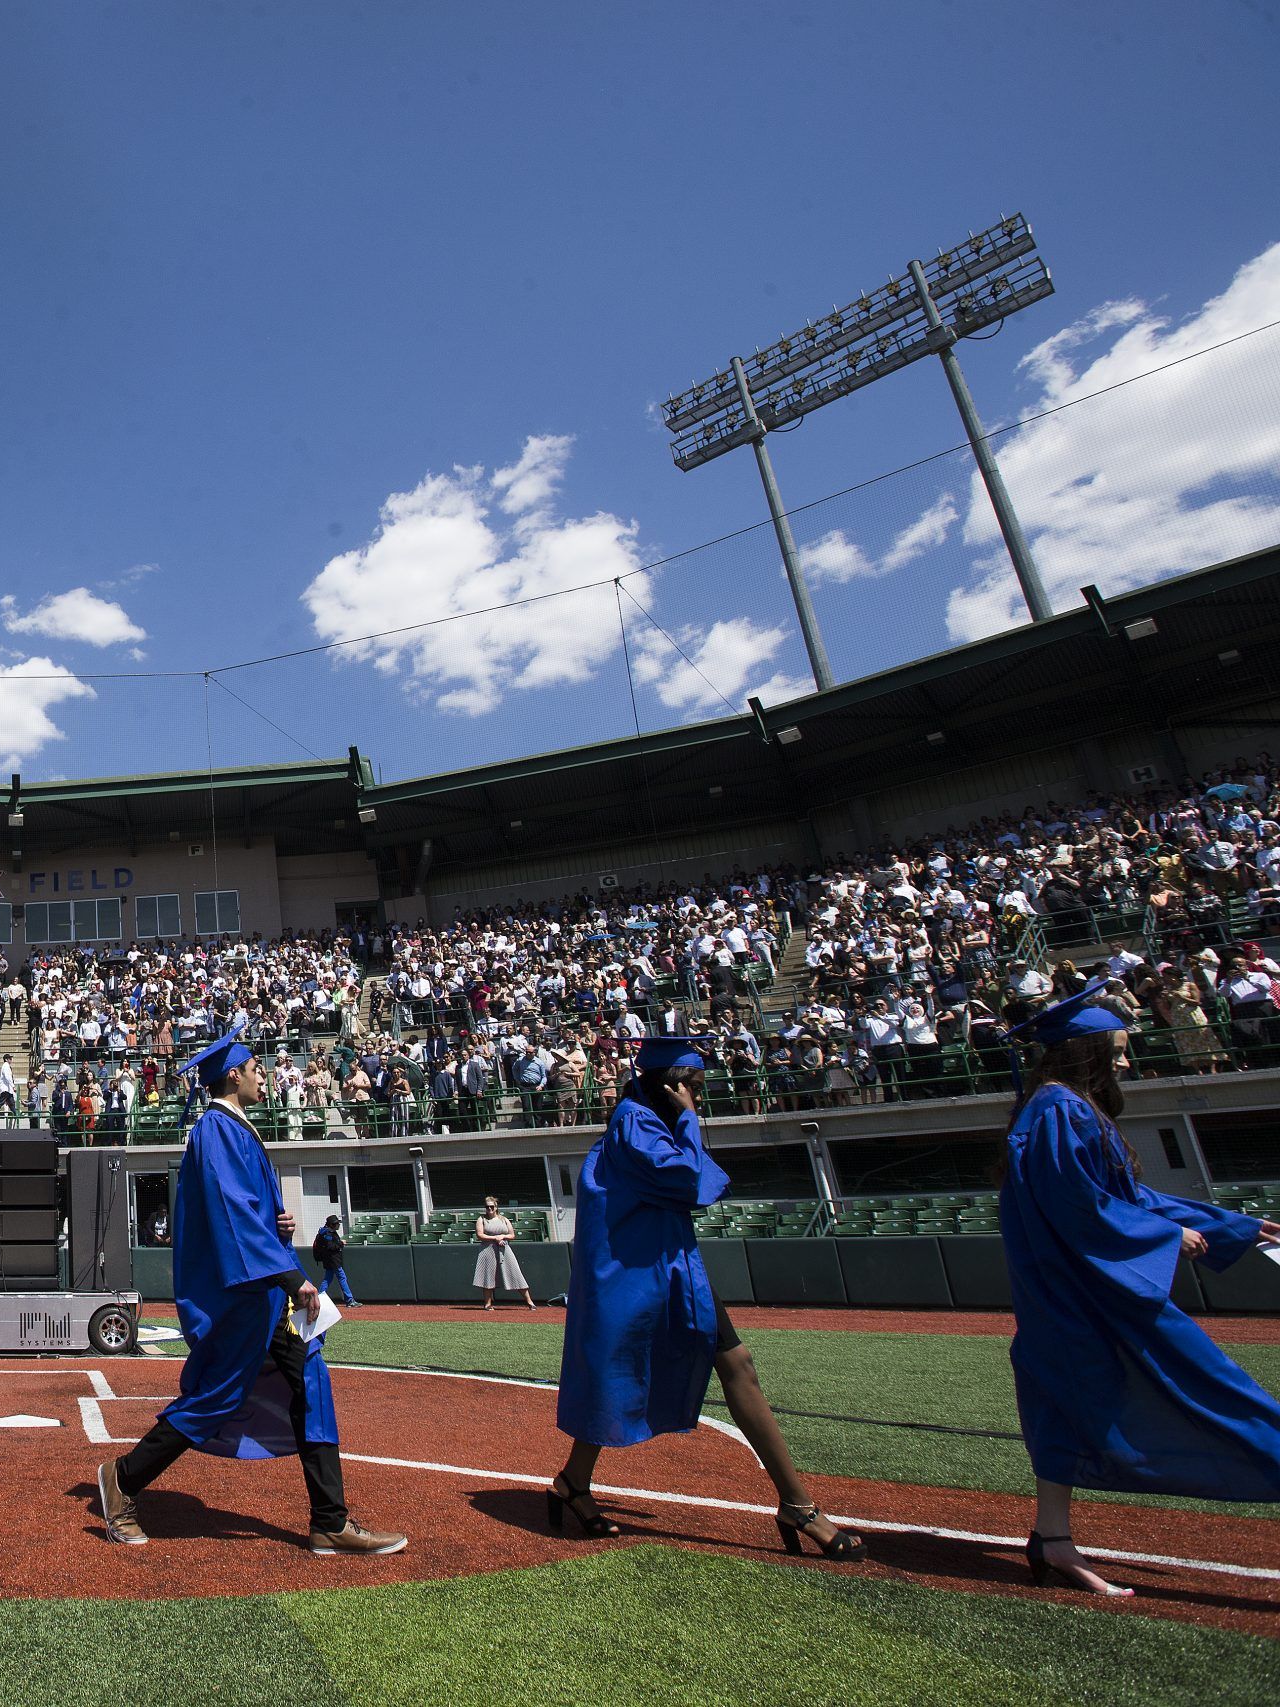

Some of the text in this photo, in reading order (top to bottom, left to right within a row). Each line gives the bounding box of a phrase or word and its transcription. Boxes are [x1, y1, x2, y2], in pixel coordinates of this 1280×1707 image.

[1132, 766, 1154, 782] H
[190, 846, 200, 855] F
[29, 867, 134, 893] FIELD
[602, 876, 616, 886] G
